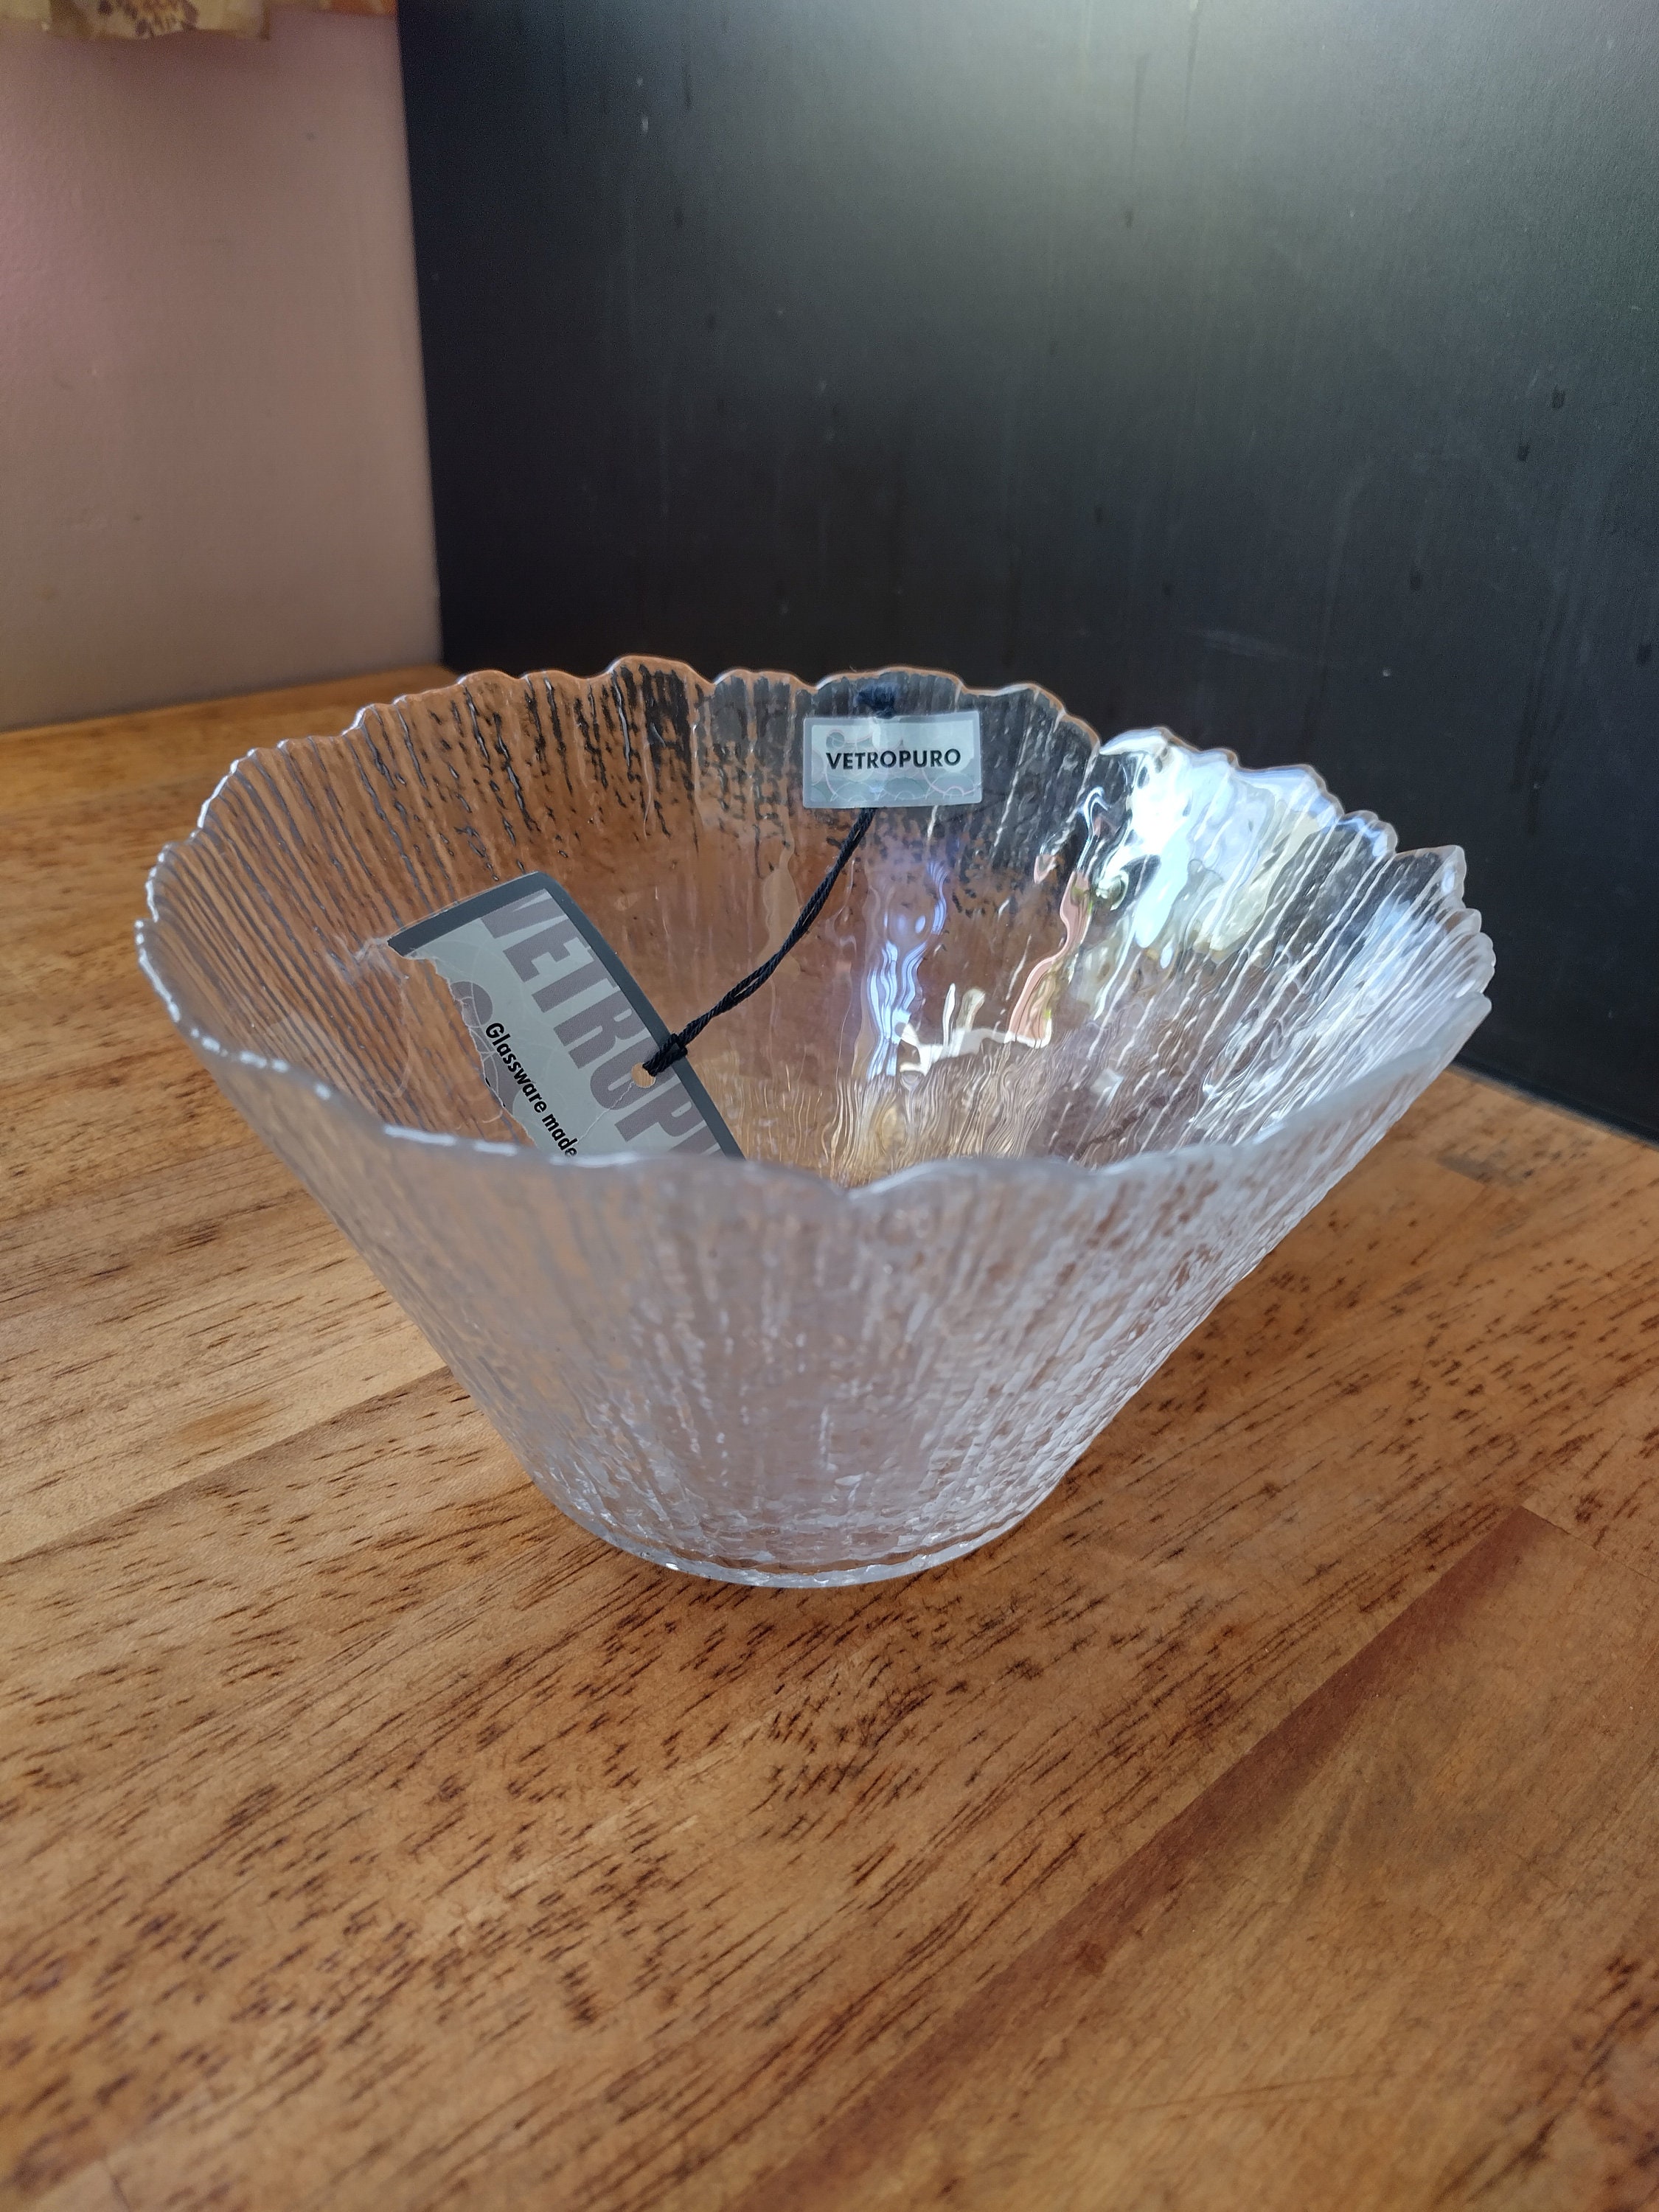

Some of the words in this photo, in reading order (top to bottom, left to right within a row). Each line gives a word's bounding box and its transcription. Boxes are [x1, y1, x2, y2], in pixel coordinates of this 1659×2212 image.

[826, 748, 961, 770] VETROPURO
[486, 1023, 547, 1113] Glassware
[542, 1114, 578, 1158] made
